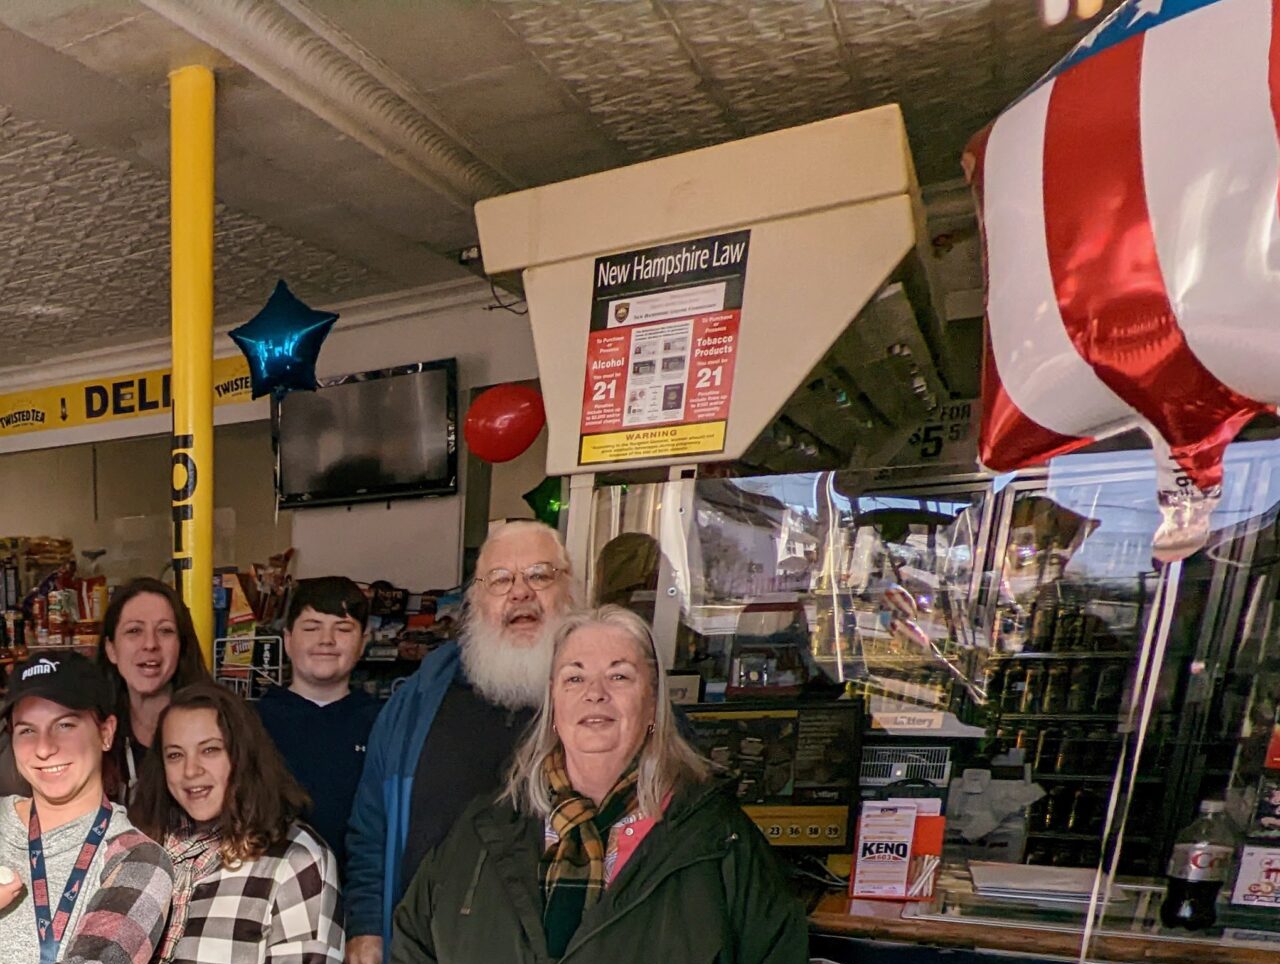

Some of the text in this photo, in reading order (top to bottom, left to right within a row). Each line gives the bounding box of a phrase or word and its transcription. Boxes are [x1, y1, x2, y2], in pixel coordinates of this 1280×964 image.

[598, 242, 746, 287] New Hampshire Law
[697, 335, 733, 346] Tobacco
[694, 346, 733, 357] Products
[592, 357, 625, 370] Alcohol
[696, 366, 723, 389] 21
[84, 374, 172, 418] DELI
[592, 379, 617, 401] 21
[0, 408, 46, 429] TWISTED TEA
[625, 429, 678, 441] WARNING
[22, 664, 51, 680] PUMA
[770, 825, 781, 835] 23
[789, 825, 800, 835] 36
[827, 825, 838, 835] 39
[861, 842, 908, 858] KENO
